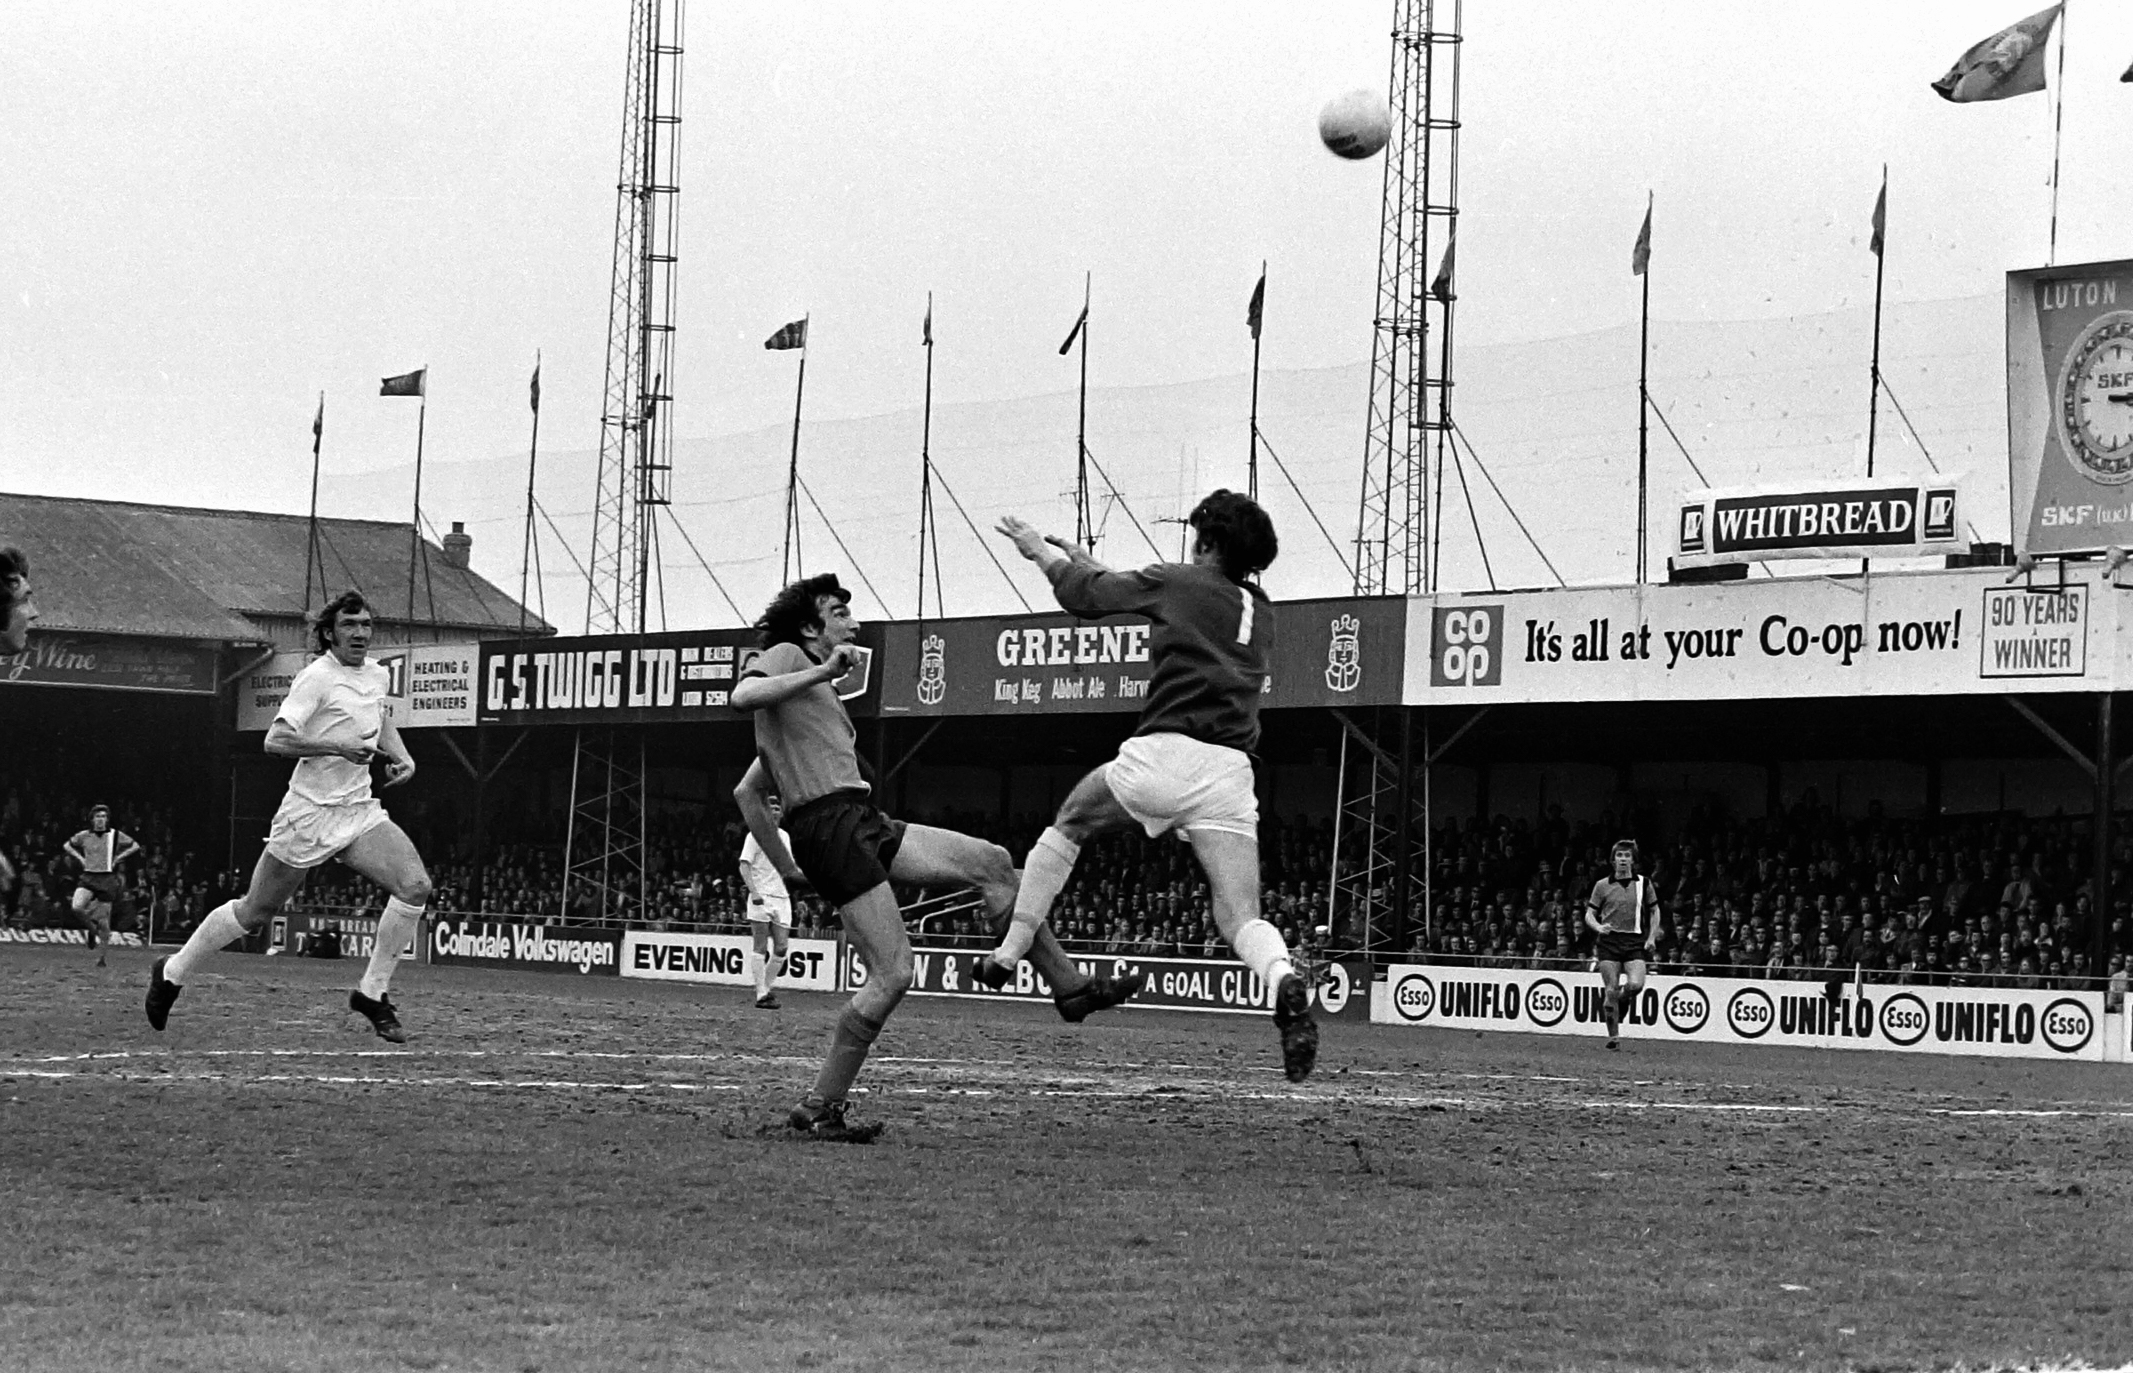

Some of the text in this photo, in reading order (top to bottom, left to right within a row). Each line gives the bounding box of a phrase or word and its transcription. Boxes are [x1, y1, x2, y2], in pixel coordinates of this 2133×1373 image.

[2043, 281, 2116, 310] LUTON
[2098, 372, 2133, 389] SKF
[1717, 500, 1912, 541] WHITBREAD
[2041, 505, 2094, 526] SKF
[1236, 586, 1254, 645] 1
[1992, 593, 2079, 626] 90 YEARS
[997, 624, 1150, 667] GREENE
[1525, 608, 1962, 669] It's all at your Co-op now!
[1995, 638, 2071, 669] WINNER
[414, 661, 469, 674] HEATING &
[628, 649, 677, 707] LTD
[412, 678, 469, 692] ELECTRICAL
[995, 679, 1019, 704] King
[1022, 678, 1042, 703] Keg
[1052, 677, 1084, 700] Abbot
[1088, 677, 1106, 699] Ale
[412, 696, 467, 710] ENGINEERS
[435, 921, 614, 974] Colindale Volkswagen
[634, 943, 744, 975] EVENING
[941, 955, 959, 990] &
[1145, 972, 1157, 994] A
[1162, 970, 1214, 1001] GOAL
[1440, 981, 1521, 1020] UNIFLO
[1779, 995, 1874, 1038] UNIFLO
[1935, 1001, 2035, 1044] UNIFLO
